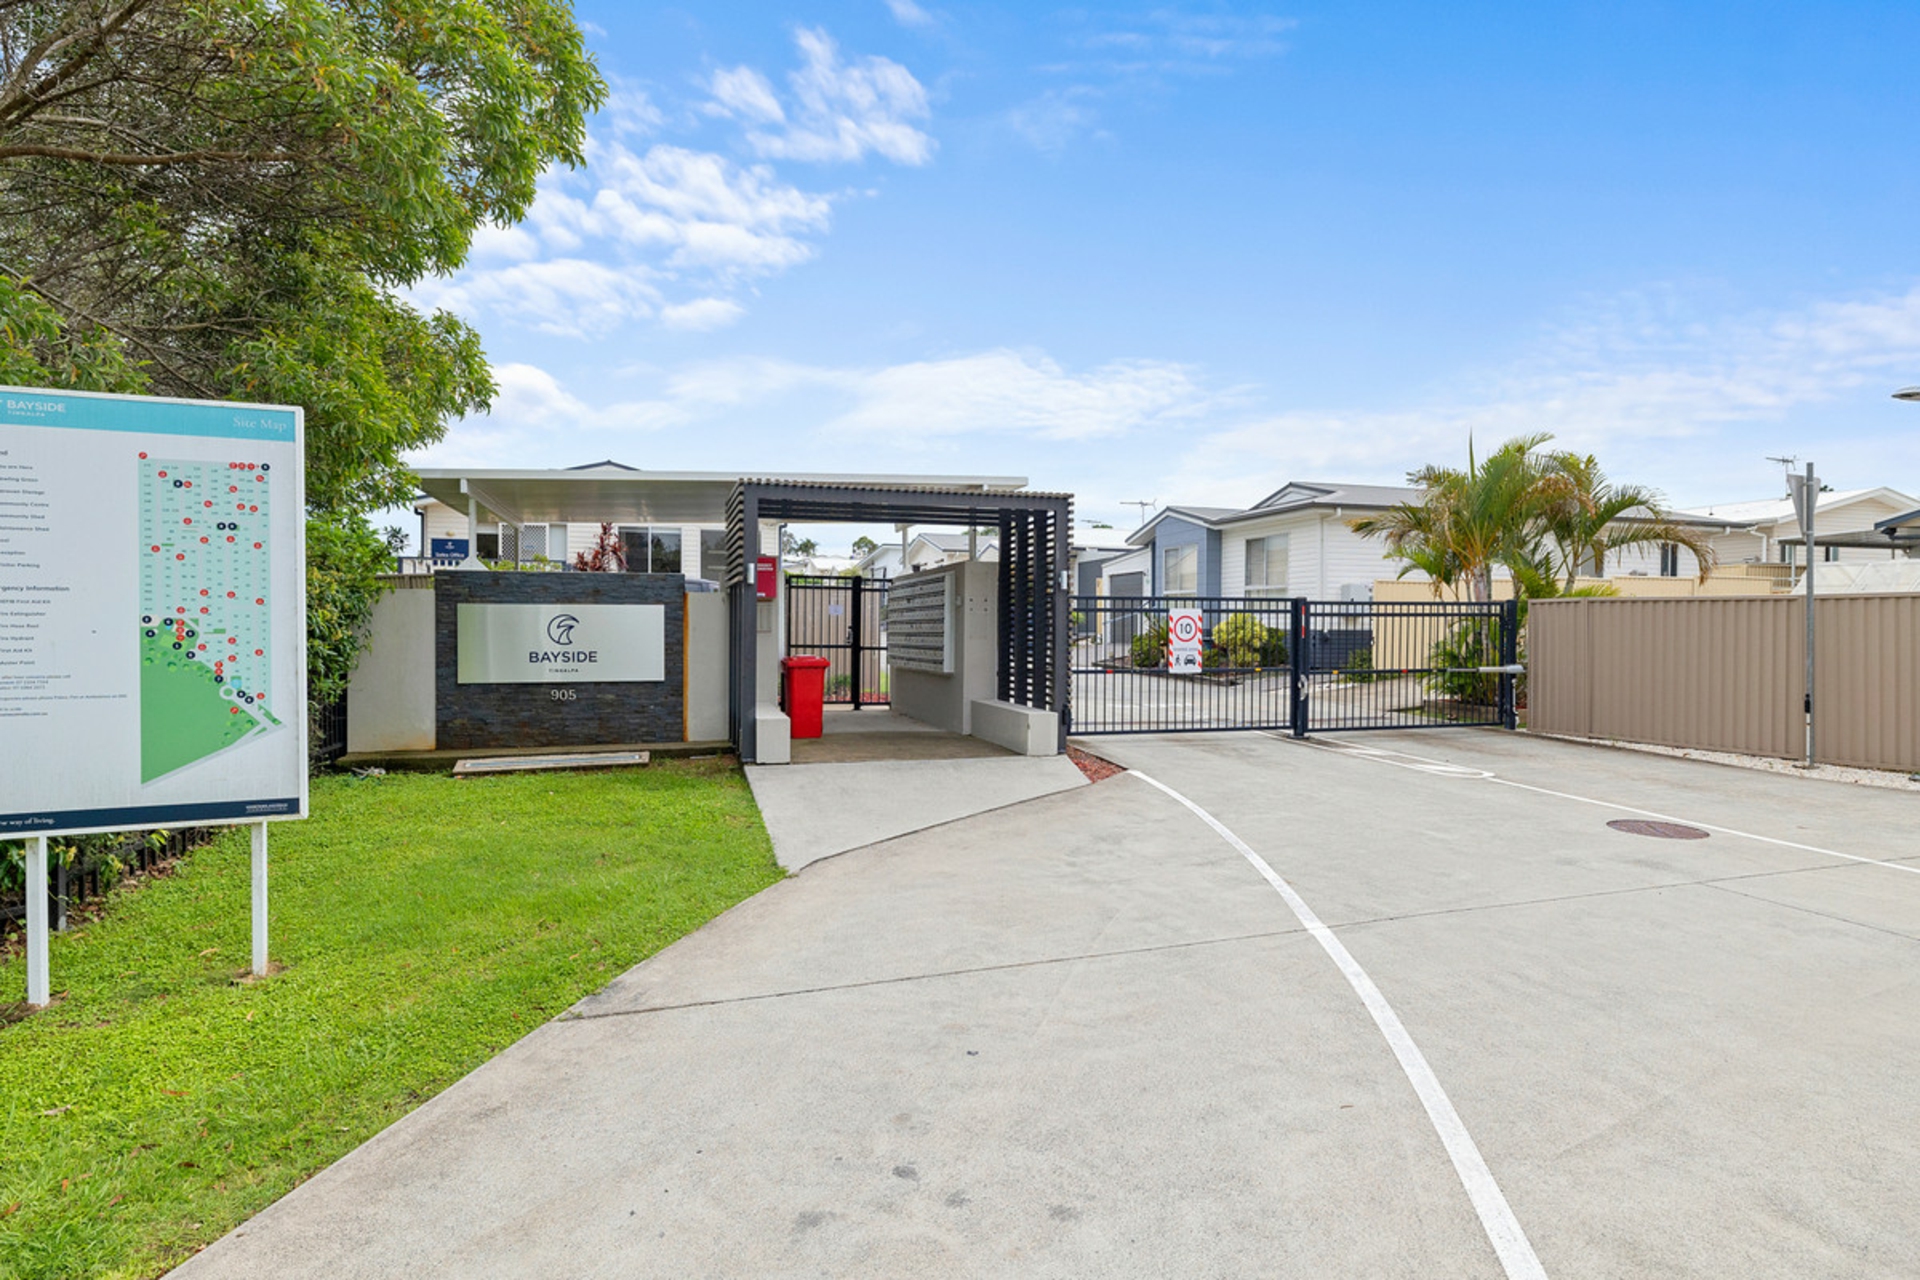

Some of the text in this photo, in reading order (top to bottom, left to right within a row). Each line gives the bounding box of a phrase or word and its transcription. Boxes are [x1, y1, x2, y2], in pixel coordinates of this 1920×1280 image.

[7, 399, 66, 413] BAYSIDE
[233, 416, 287, 433] Site Map
[1180, 623, 1193, 635] 10
[529, 650, 598, 663] BAYSIDE
[550, 688, 577, 701] 905
